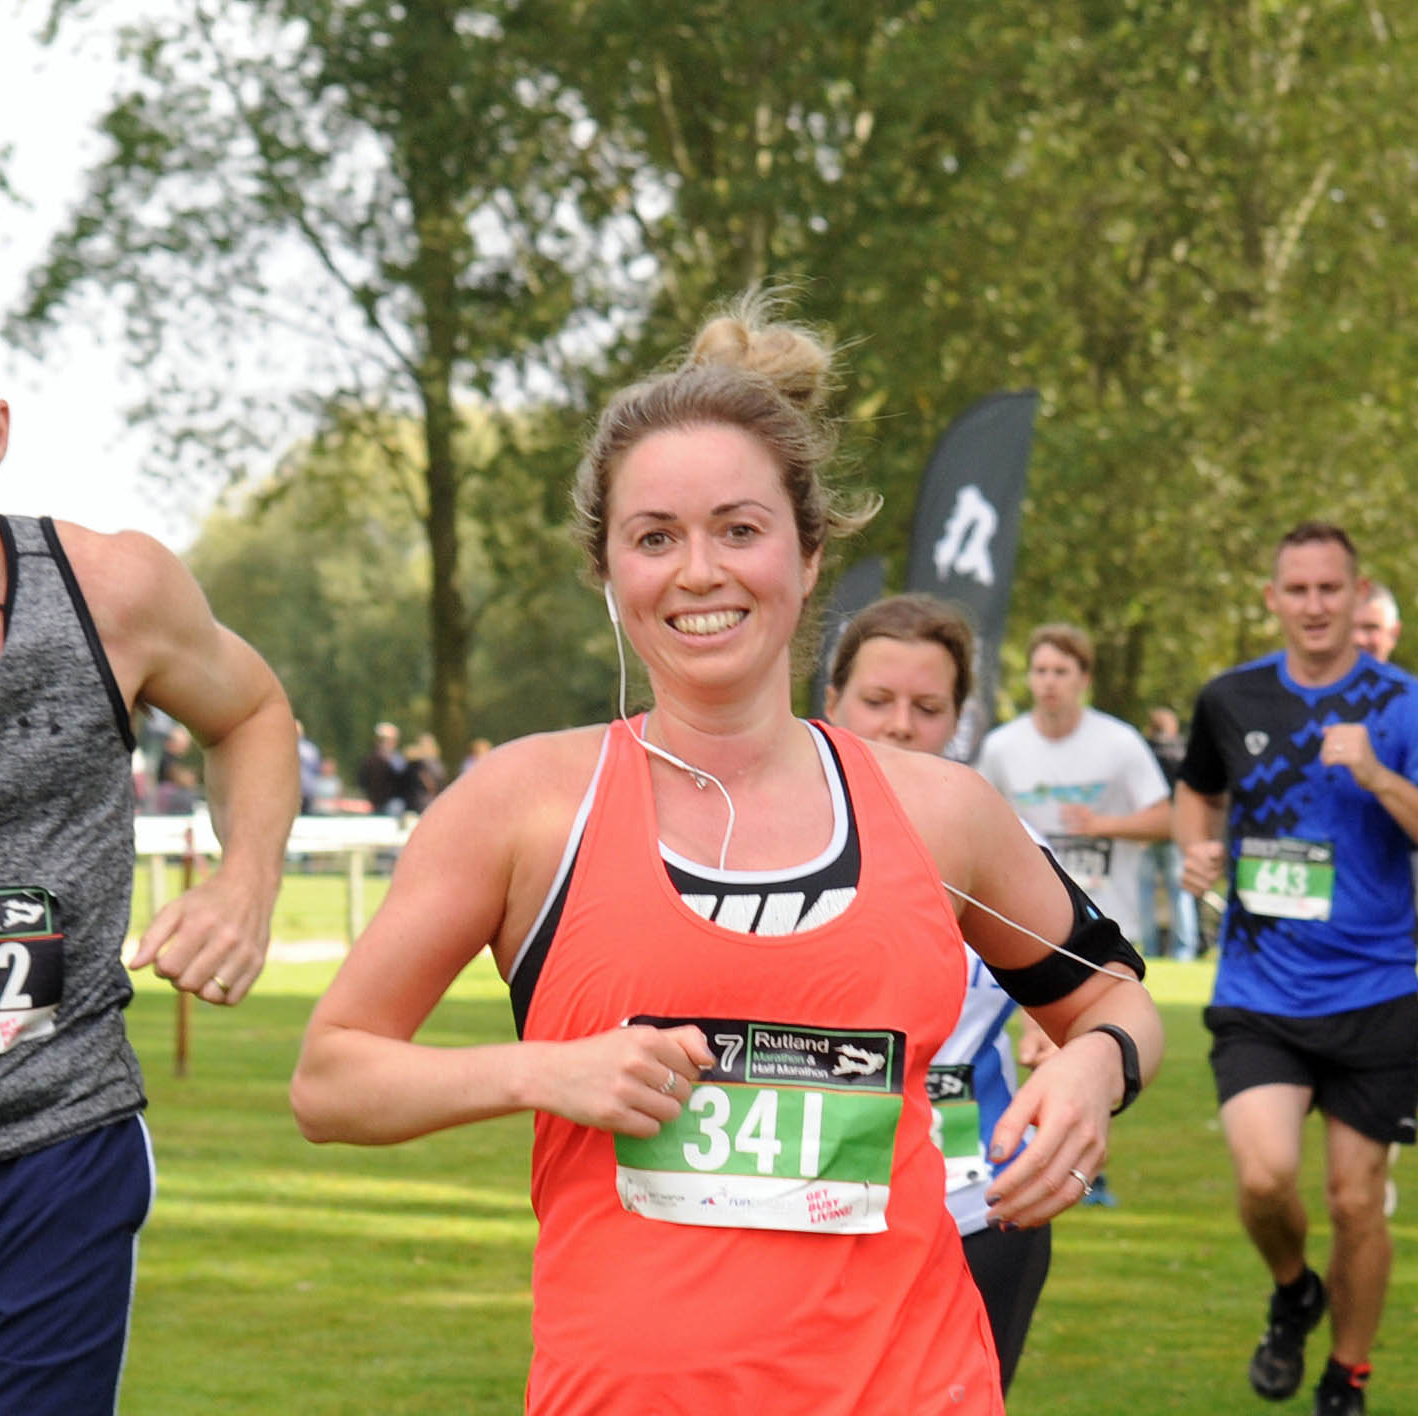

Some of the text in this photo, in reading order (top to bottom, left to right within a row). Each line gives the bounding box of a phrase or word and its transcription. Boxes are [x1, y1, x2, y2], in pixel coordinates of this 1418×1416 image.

[1255, 860, 1309, 896] 643
[754, 1031, 829, 1054] Rutland
[753, 1050, 817, 1067] Marathon &
[752, 1062, 829, 1080] Half Marathon
[683, 1085, 822, 1177] 341
